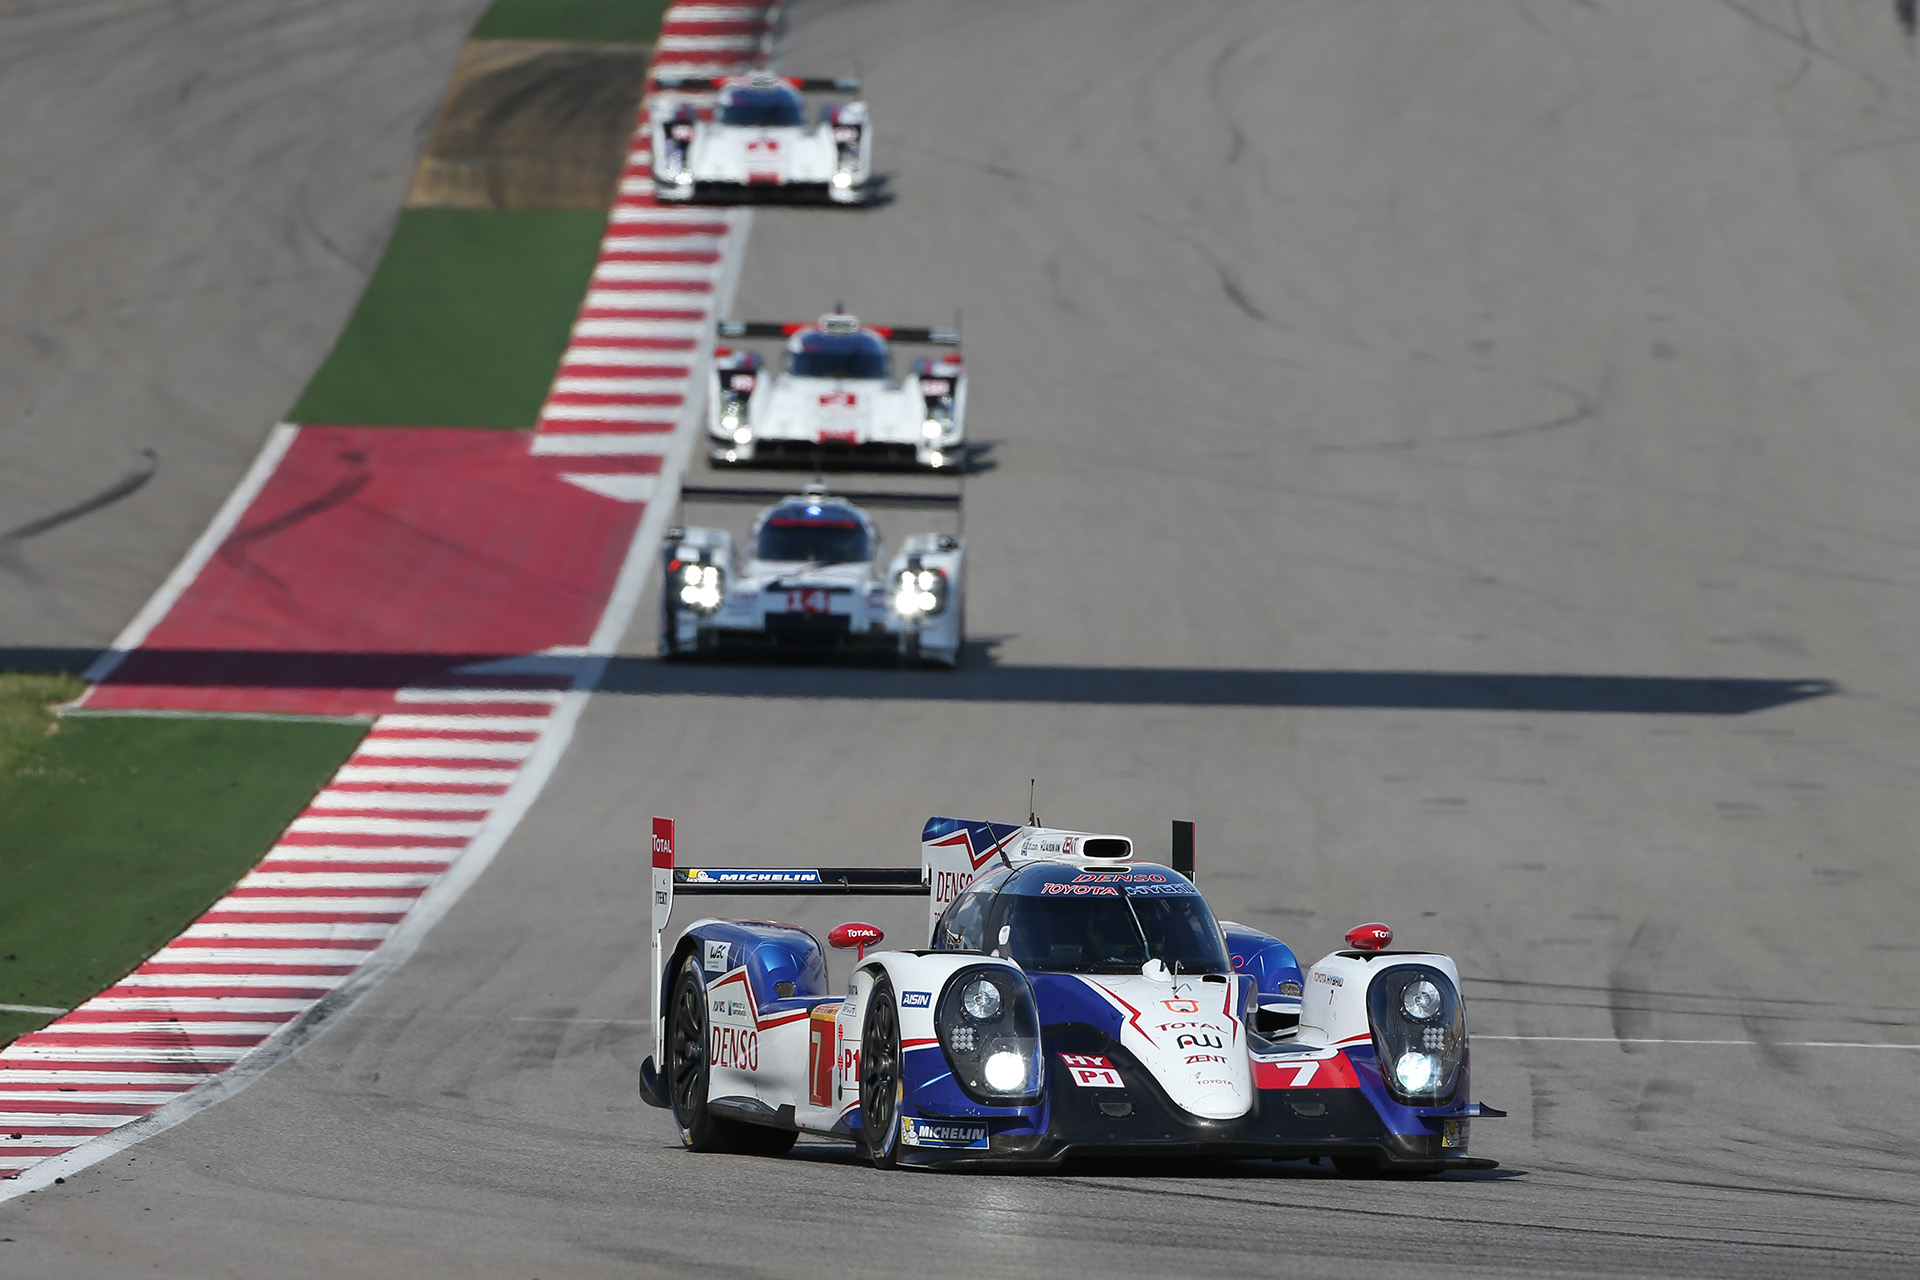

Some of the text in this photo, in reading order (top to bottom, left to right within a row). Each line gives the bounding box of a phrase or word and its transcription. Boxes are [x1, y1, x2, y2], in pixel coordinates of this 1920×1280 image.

[790, 590, 828, 613] 14
[652, 834, 672, 853] TOTAL
[720, 874, 816, 882] MICHELIN
[1072, 874, 1167, 883] DENSO
[1041, 883, 1119, 896] TOYOTA
[847, 929, 877, 938] TOTAL
[902, 993, 930, 1006] AISIN
[1155, 1022, 1229, 1035] TOTAL
[711, 1026, 758, 1071] DENSO
[811, 1030, 822, 1098] 7
[844, 1048, 860, 1082] P1
[1062, 1054, 1104, 1066] HY
[1184, 1055, 1228, 1065] ZENT
[1077, 1070, 1115, 1085] P1
[1275, 1061, 1320, 1087] 7
[1196, 1079, 1234, 1087] TOYOTA
[919, 1125, 985, 1140] MICHELIN
